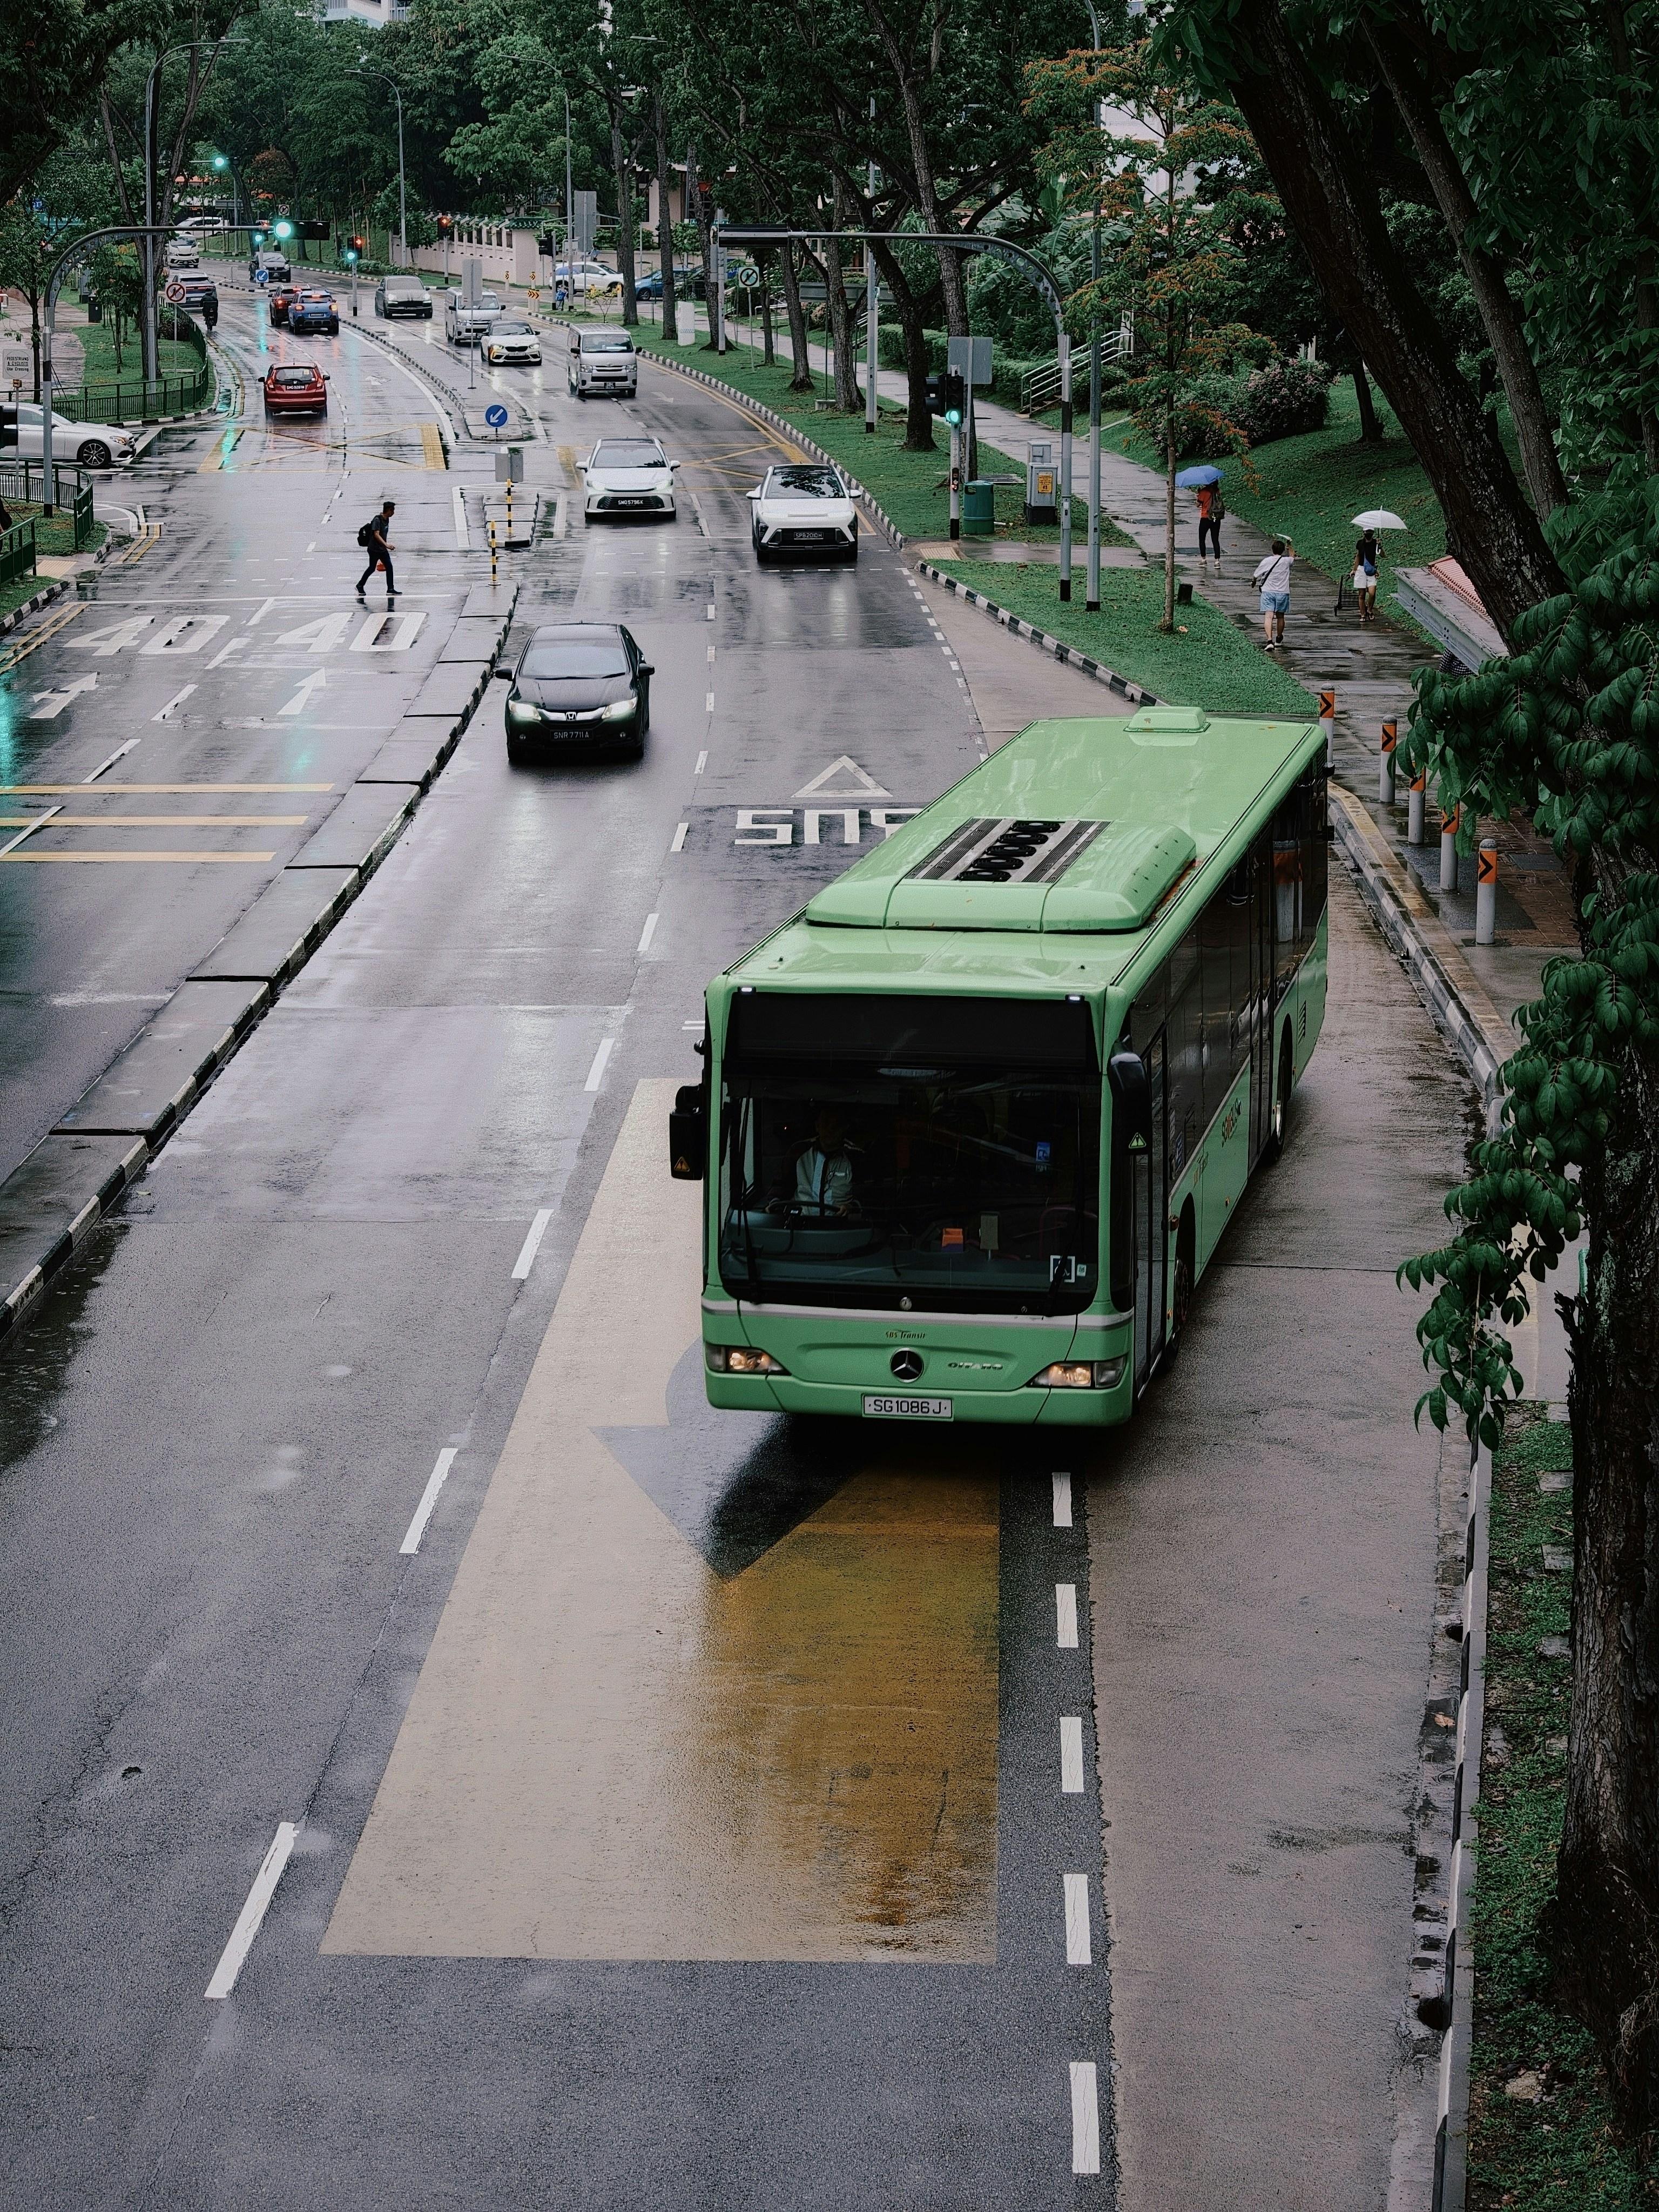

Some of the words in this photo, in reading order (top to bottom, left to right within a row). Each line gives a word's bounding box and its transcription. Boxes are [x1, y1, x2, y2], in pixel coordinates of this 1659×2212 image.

[63, 615, 231, 656] 40
[273, 611, 428, 653] 40
[554, 731, 589, 739] SNR7711A
[900, 1330, 926, 1339] Transit
[873, 1399, 942, 1415] SG1086J
